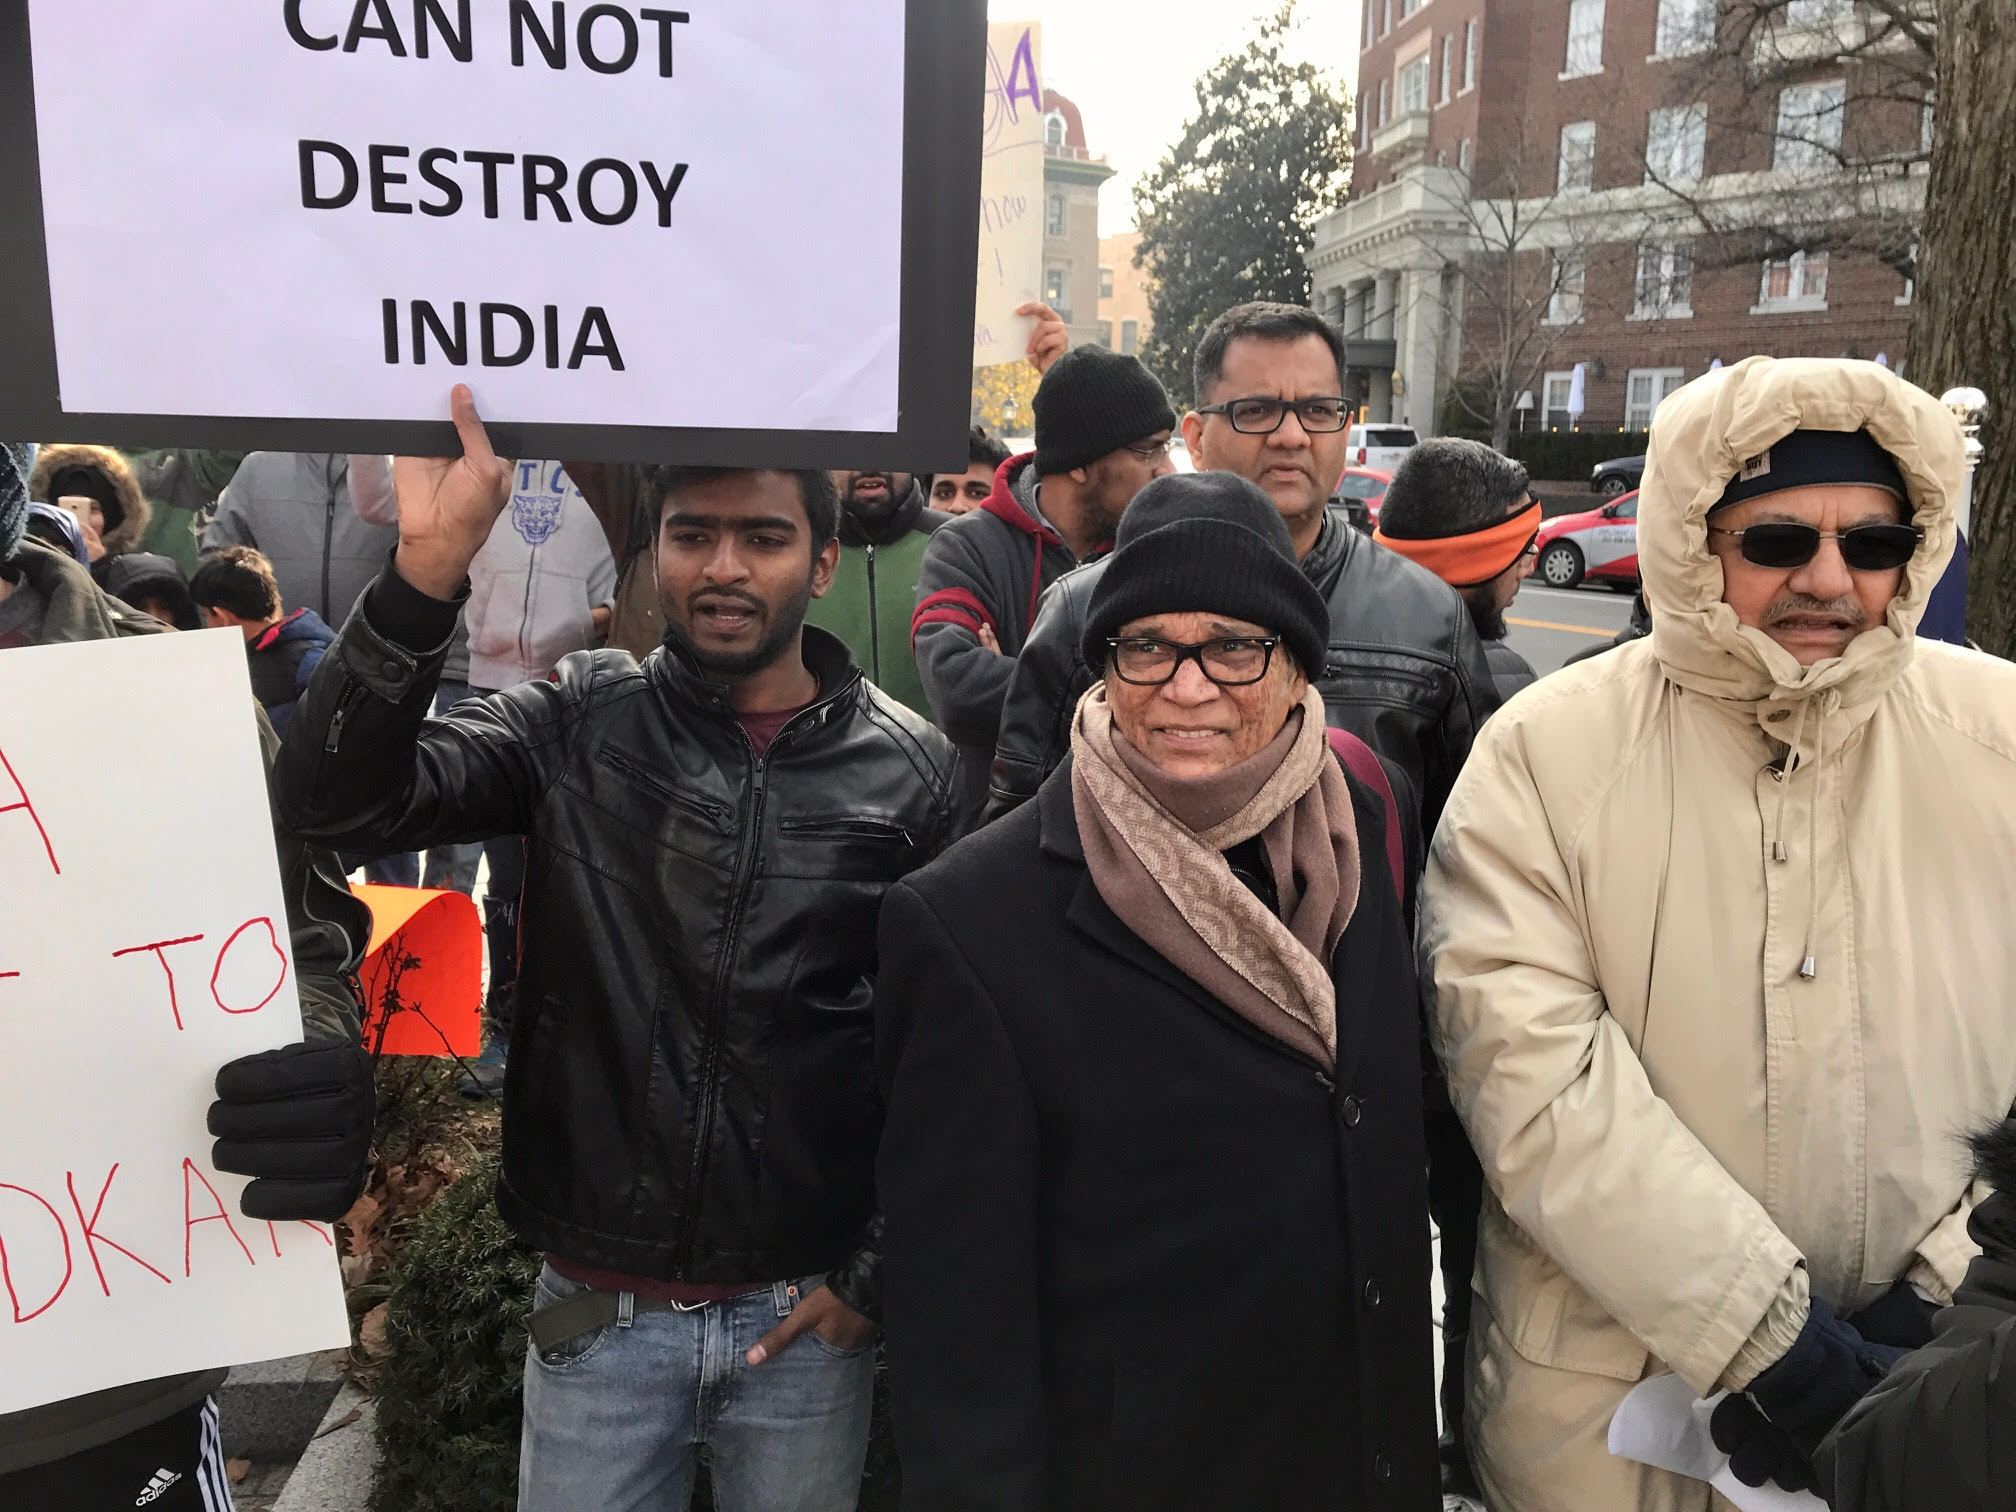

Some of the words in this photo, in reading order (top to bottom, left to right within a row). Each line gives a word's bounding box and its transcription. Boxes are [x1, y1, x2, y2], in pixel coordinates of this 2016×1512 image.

[284, 0, 473, 62] CAN
[509, 0, 690, 78] NOT
[299, 140, 689, 228] DESTROY
[383, 299, 626, 371] INDIA
[112, 916, 288, 1031] TO
[136, 1473, 182, 1506] adidas
